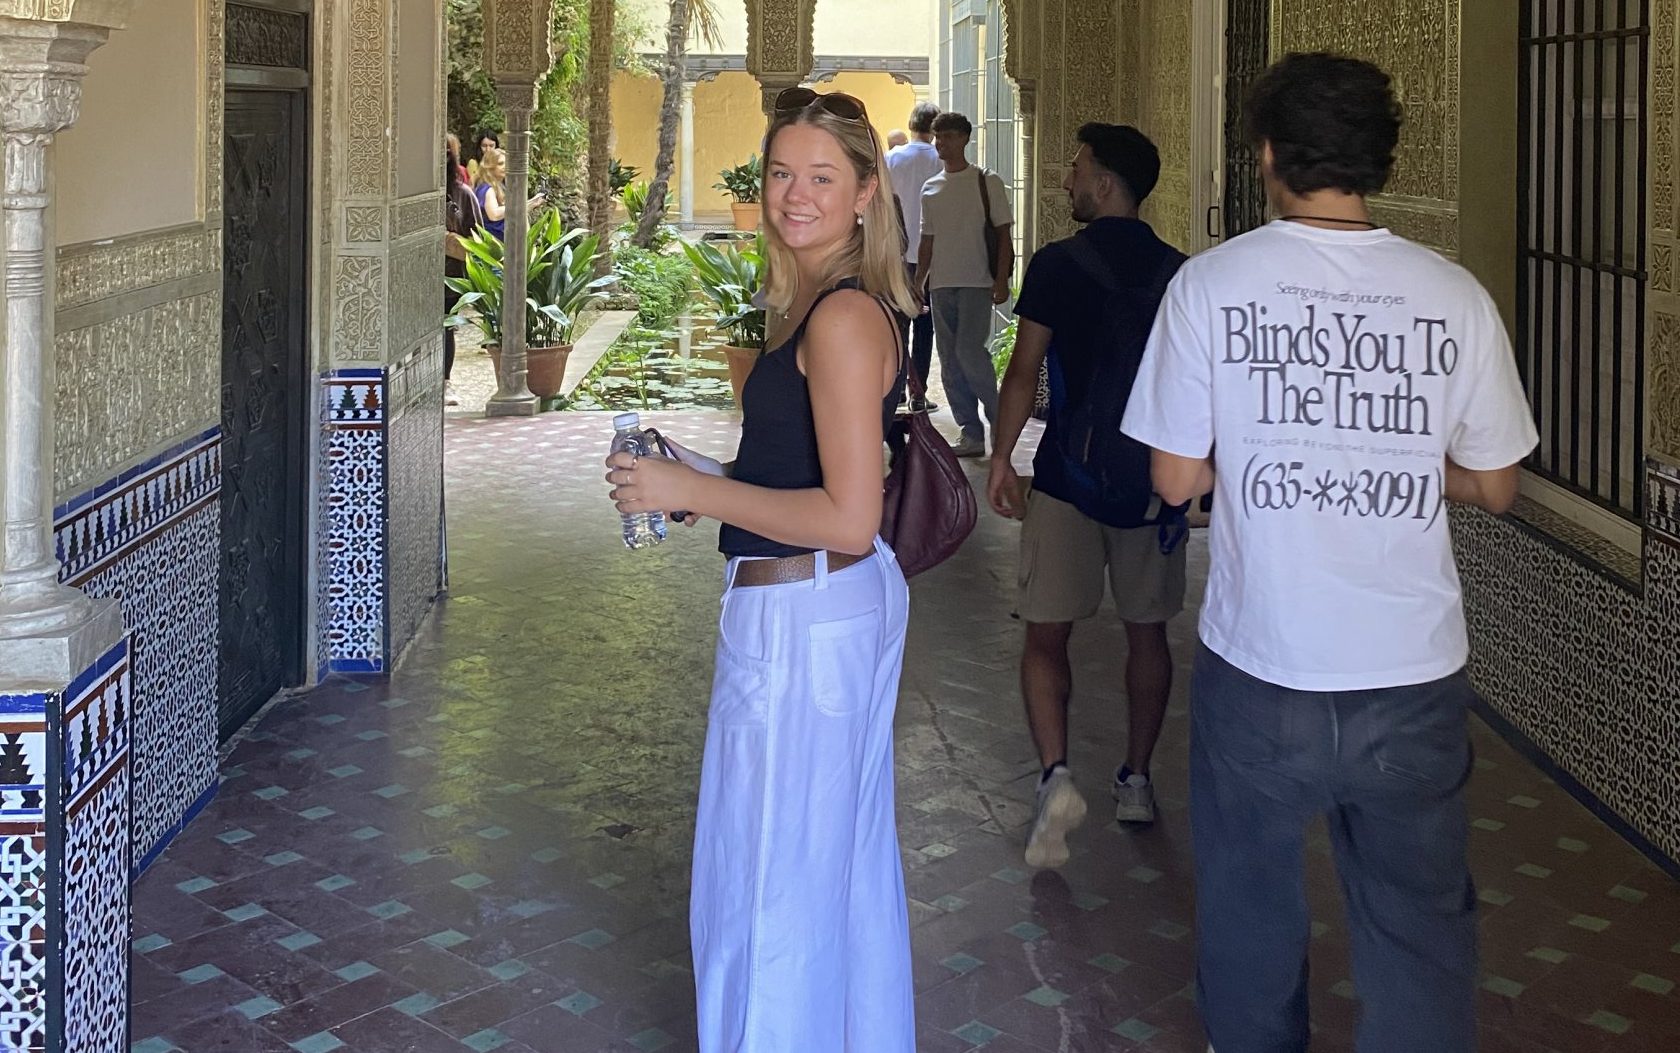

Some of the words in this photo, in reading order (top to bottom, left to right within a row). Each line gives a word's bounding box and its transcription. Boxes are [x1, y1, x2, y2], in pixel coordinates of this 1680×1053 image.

[1220, 301, 1330, 368] Blinds
[1331, 312, 1407, 374] You
[1413, 317, 1458, 376] To
[1248, 365, 1323, 426] The
[1324, 370, 1432, 435] Truth
